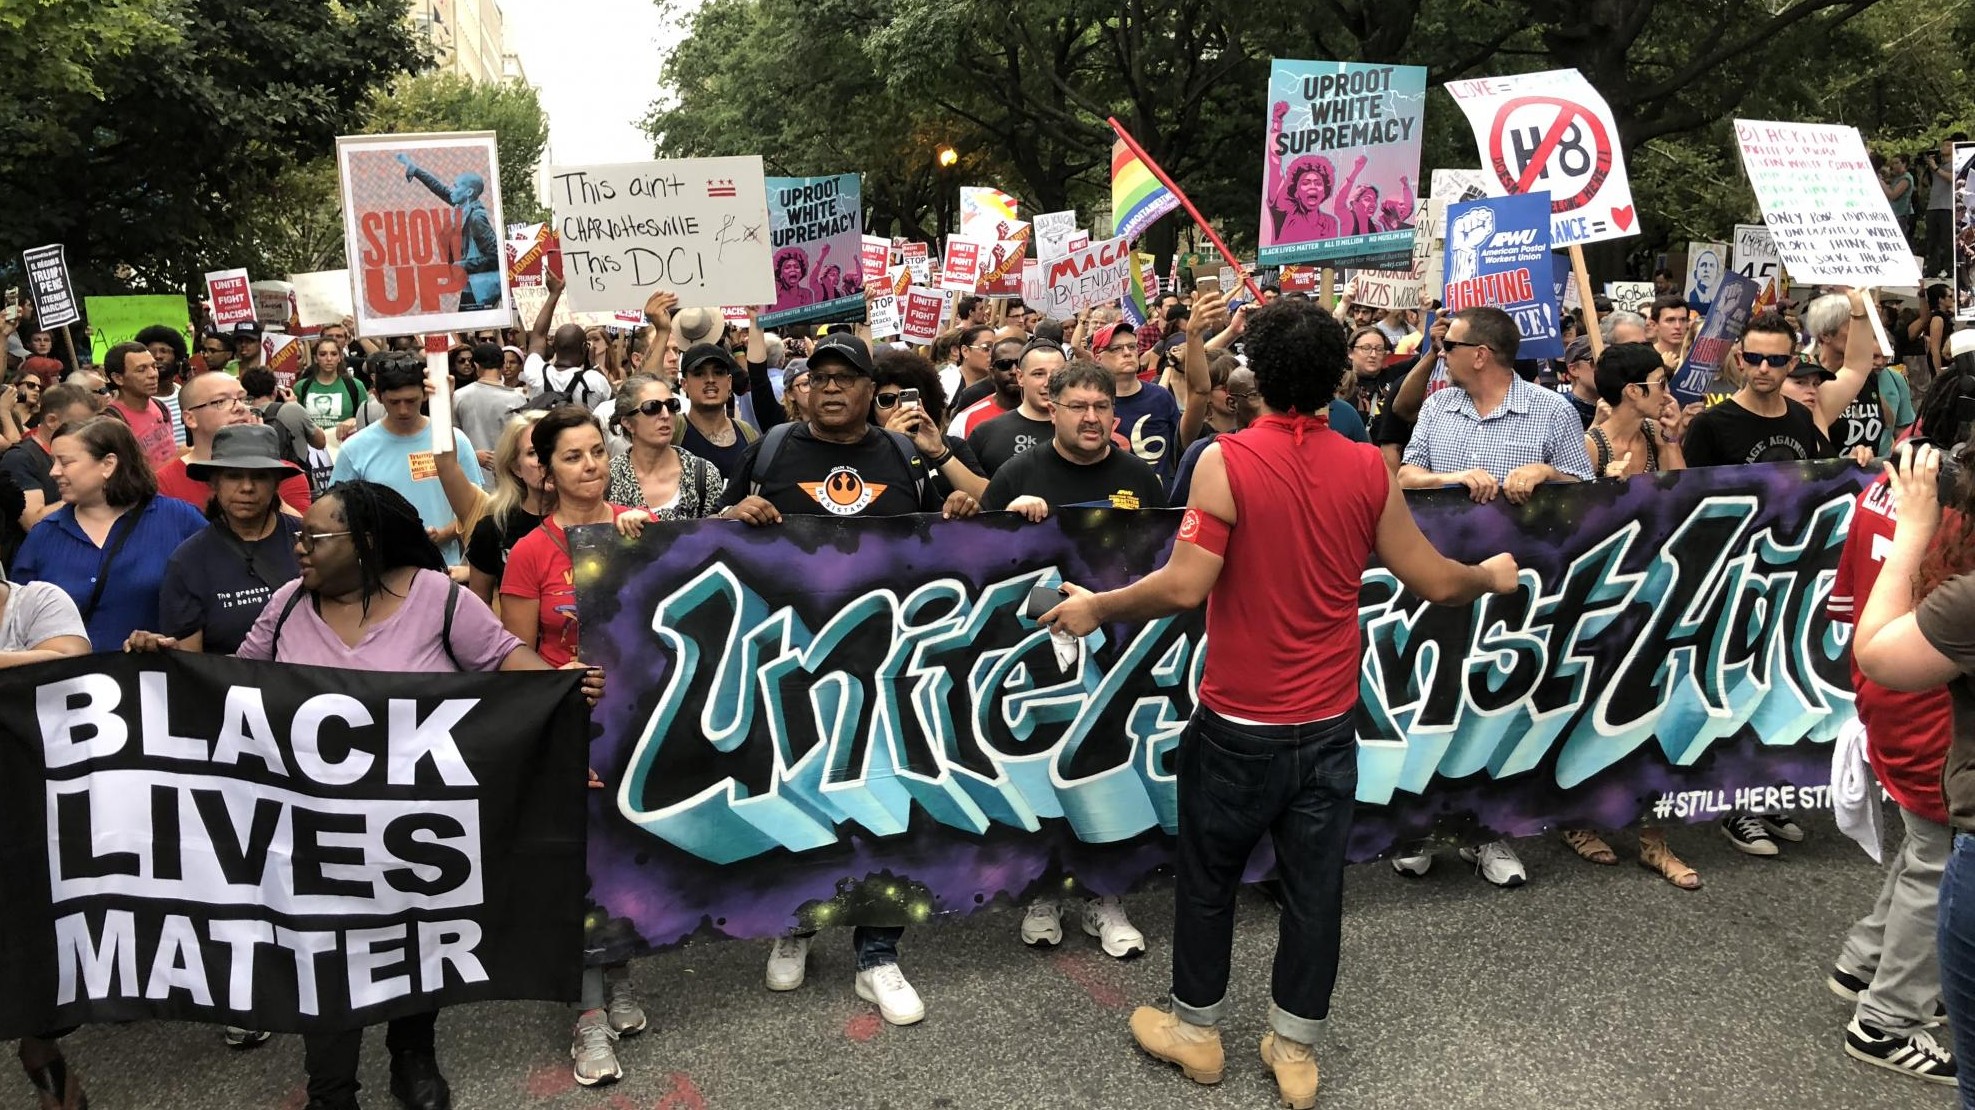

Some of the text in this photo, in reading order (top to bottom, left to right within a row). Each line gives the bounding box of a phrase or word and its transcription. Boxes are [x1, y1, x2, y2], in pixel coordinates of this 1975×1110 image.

[1304, 67, 1394, 100] UPROOT
[1449, 80, 1497, 99] LOVE
[1311, 95, 1384, 126] WHITE
[1275, 116, 1416, 156] SUPREMACY
[553, 171, 686, 206] This ain't
[780, 177, 842, 207] UPROOT
[786, 199, 838, 226] WHITE
[1416, 199, 1428, 218] A
[1551, 197, 1582, 213] ELONG
[1766, 212, 1803, 225] ONLY
[361, 207, 464, 268] SHOW
[771, 211, 857, 248] UPREMACY
[1415, 219, 1436, 238] AN
[952, 243, 975, 253] UNITE
[1488, 229, 1538, 248] APWU
[1829, 239, 1872, 250] THINK
[862, 244, 885, 255] UNITE
[1413, 242, 1431, 258] ELL
[1481, 244, 1547, 257] American Postal
[1485, 253, 1542, 264] Workers Union
[507, 245, 543, 281] OLIDARITY
[564, 247, 706, 288] This DC!
[904, 257, 926, 265] STOP
[950, 257, 974, 267] FIGHT
[214, 278, 243, 290] UNITE
[365, 264, 468, 316] UP
[1054, 282, 1074, 305] BY
[1080, 260, 1130, 294] ENDING
[1445, 267, 1535, 315] FIGHTING
[218, 293, 244, 305] FIGHT
[913, 295, 938, 307] UNITE
[1354, 279, 1391, 307] NAZIS
[217, 309, 252, 321] RACISM
[911, 310, 936, 320] FIGHT
[905, 324, 936, 335] RACISM
[273, 372, 295, 380] RUMPS
[1014, 434, 1038, 445] Ok
[1844, 418, 1883, 446] DO
[1745, 435, 1807, 464] AGE AGAINS
[818, 489, 870, 513] RESISTANCE
[236, 586, 269, 598] greates
[237, 597, 263, 606] being
[36, 670, 481, 787] BLACK
[1652, 789, 1733, 820] #STILL
[1735, 785, 1797, 813] HERE
[56, 784, 472, 899] LIVES
[55, 908, 490, 1016] MATTER
